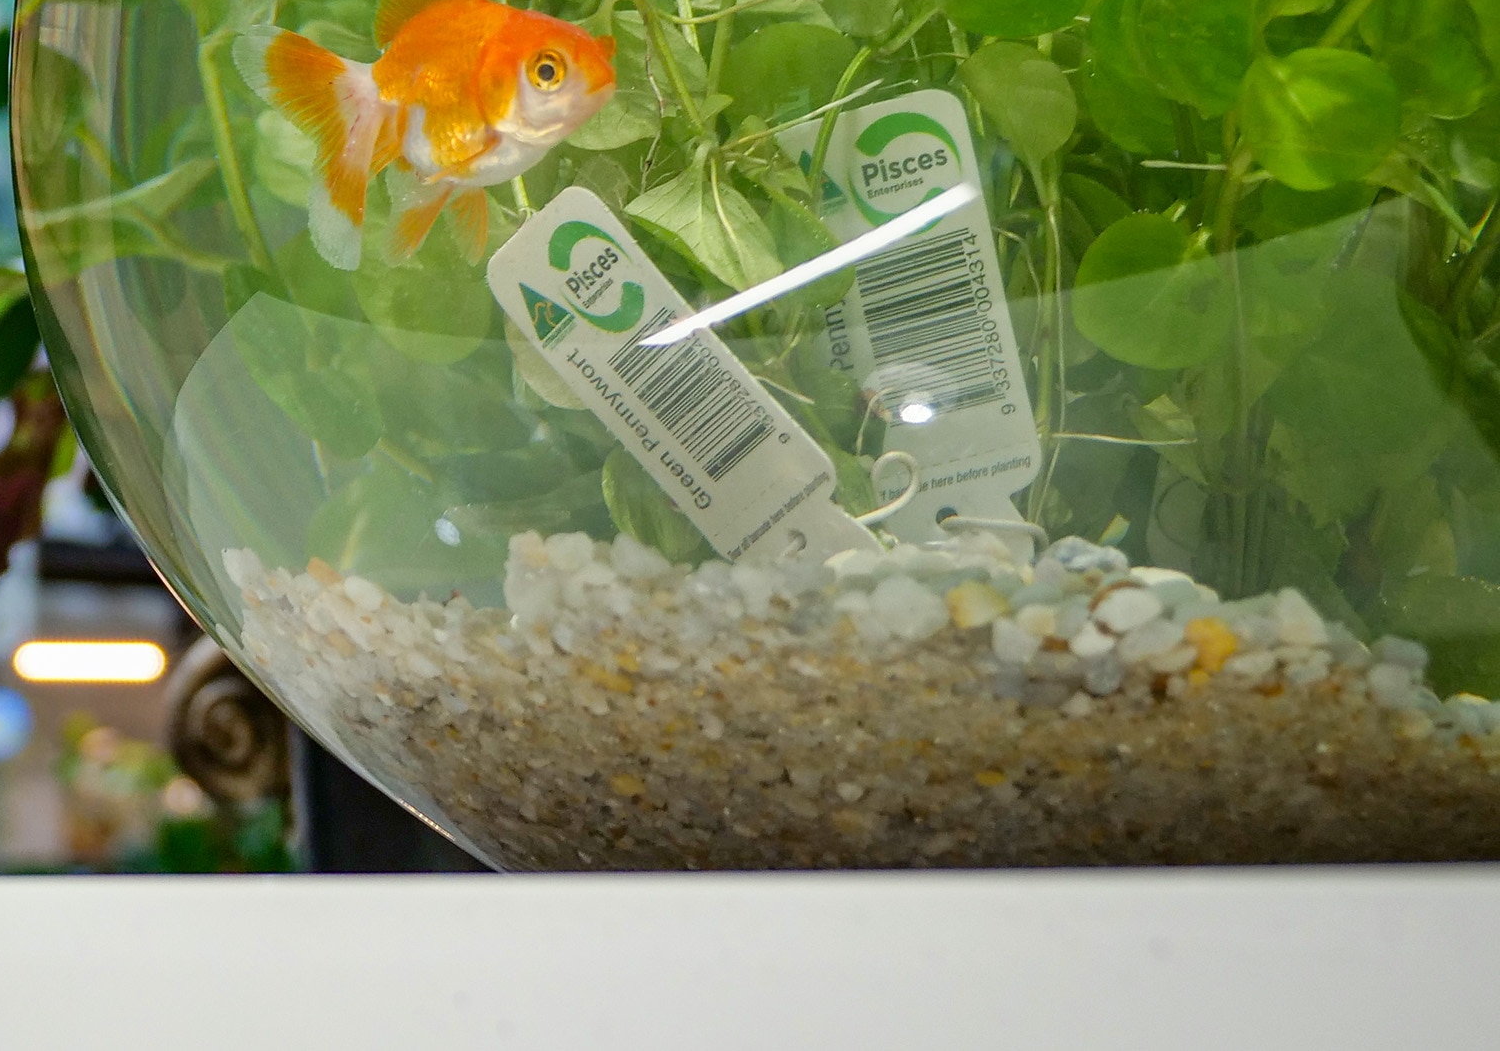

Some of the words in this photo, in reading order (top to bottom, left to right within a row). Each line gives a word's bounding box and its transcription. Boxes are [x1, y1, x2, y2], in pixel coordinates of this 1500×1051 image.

[861, 149, 948, 188] Pisces
[866, 177, 924, 199] Enterprises
[565, 247, 619, 299] Pisces
[981, 319, 1011, 391] 337280
[566, 348, 660, 452] Pennywort
[1000, 403, 1016, 416] 9
[660, 451, 712, 509] Green
[931, 474, 954, 490] here
[956, 467, 989, 483] before
[991, 455, 1031, 476] planting
